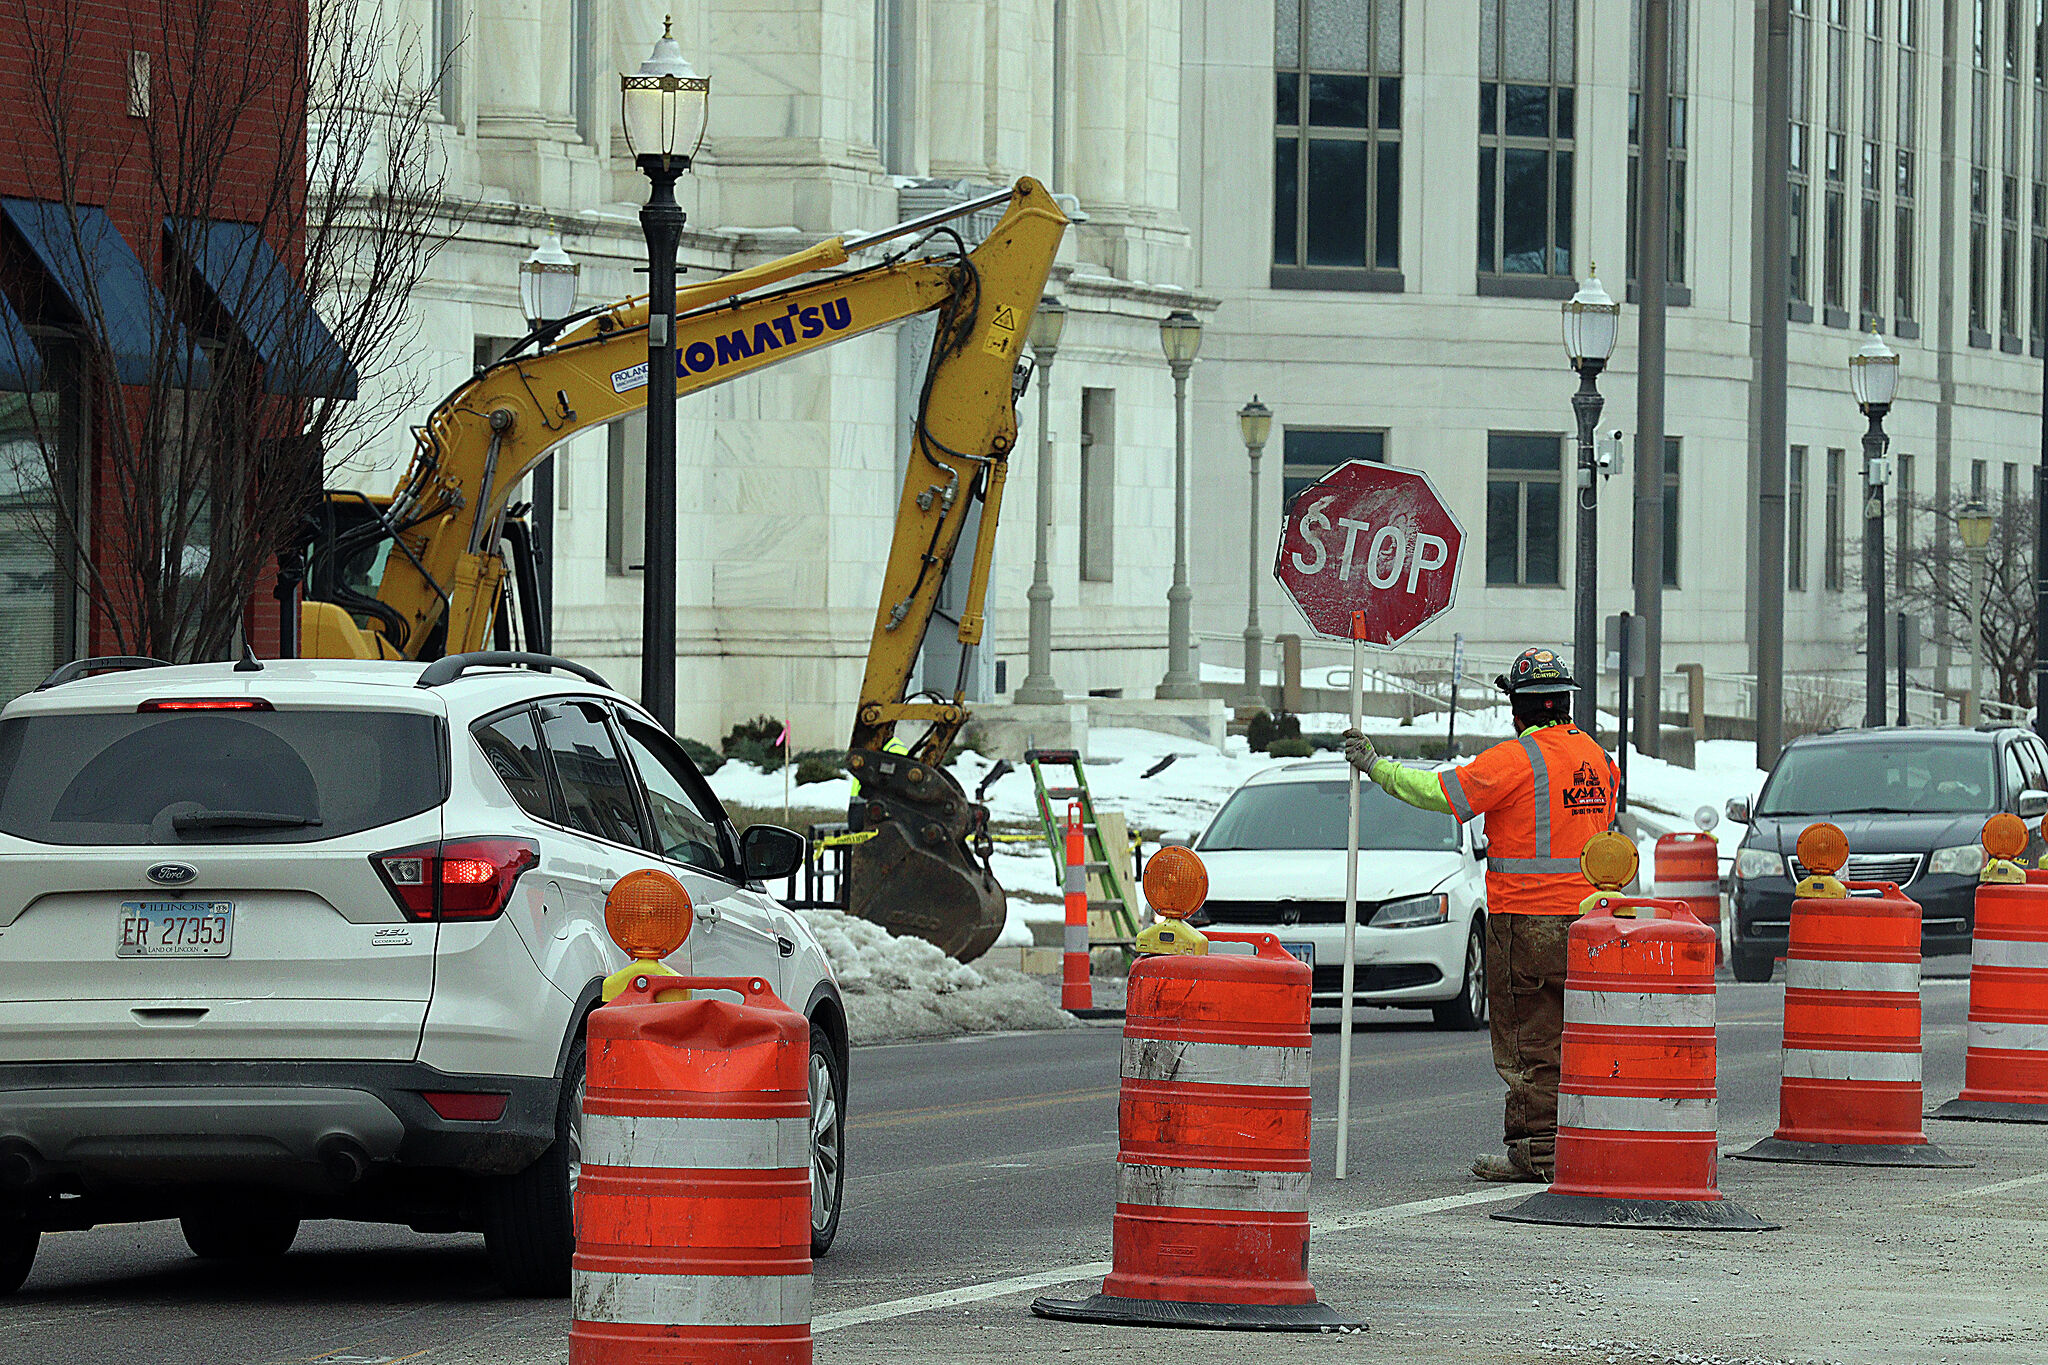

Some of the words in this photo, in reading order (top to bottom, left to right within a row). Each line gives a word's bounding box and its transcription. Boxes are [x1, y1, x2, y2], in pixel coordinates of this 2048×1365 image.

[1291, 495, 1448, 594] STOP
[158, 866, 186, 879] Ford
[149, 903, 205, 912] ILLINOIS
[123, 917, 150, 946] ER
[161, 916, 227, 945] 27353
[374, 928, 409, 937] SEL
